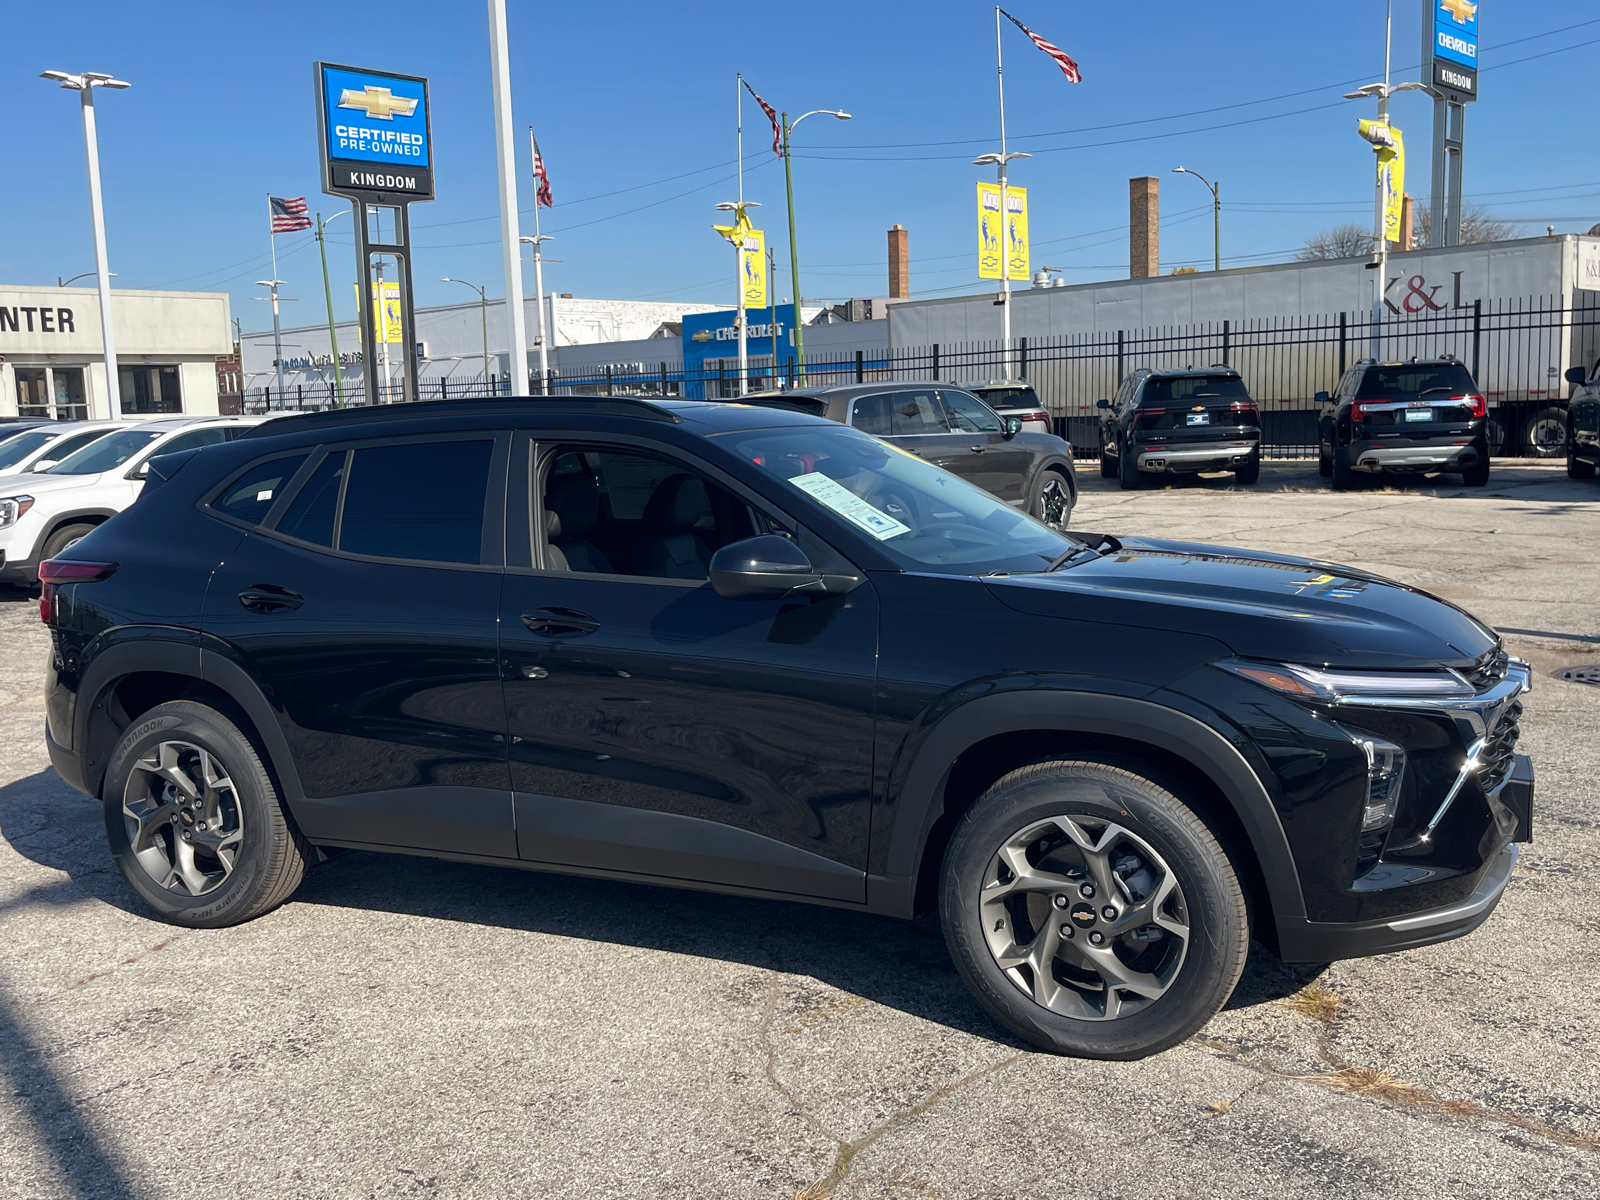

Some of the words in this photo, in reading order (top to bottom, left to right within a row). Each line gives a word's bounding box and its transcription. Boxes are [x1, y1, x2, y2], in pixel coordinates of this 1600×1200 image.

[1438, 32, 1476, 58] CHEVROLET
[1441, 69, 1472, 90] KINGDOM
[335, 125, 423, 146] CERTIFIED
[340, 138, 421, 157] PRE-OWNED
[350, 171, 416, 190] KINGDOM
[0, 306, 75, 333] NTER
[716, 322, 784, 341] CHEROLET
